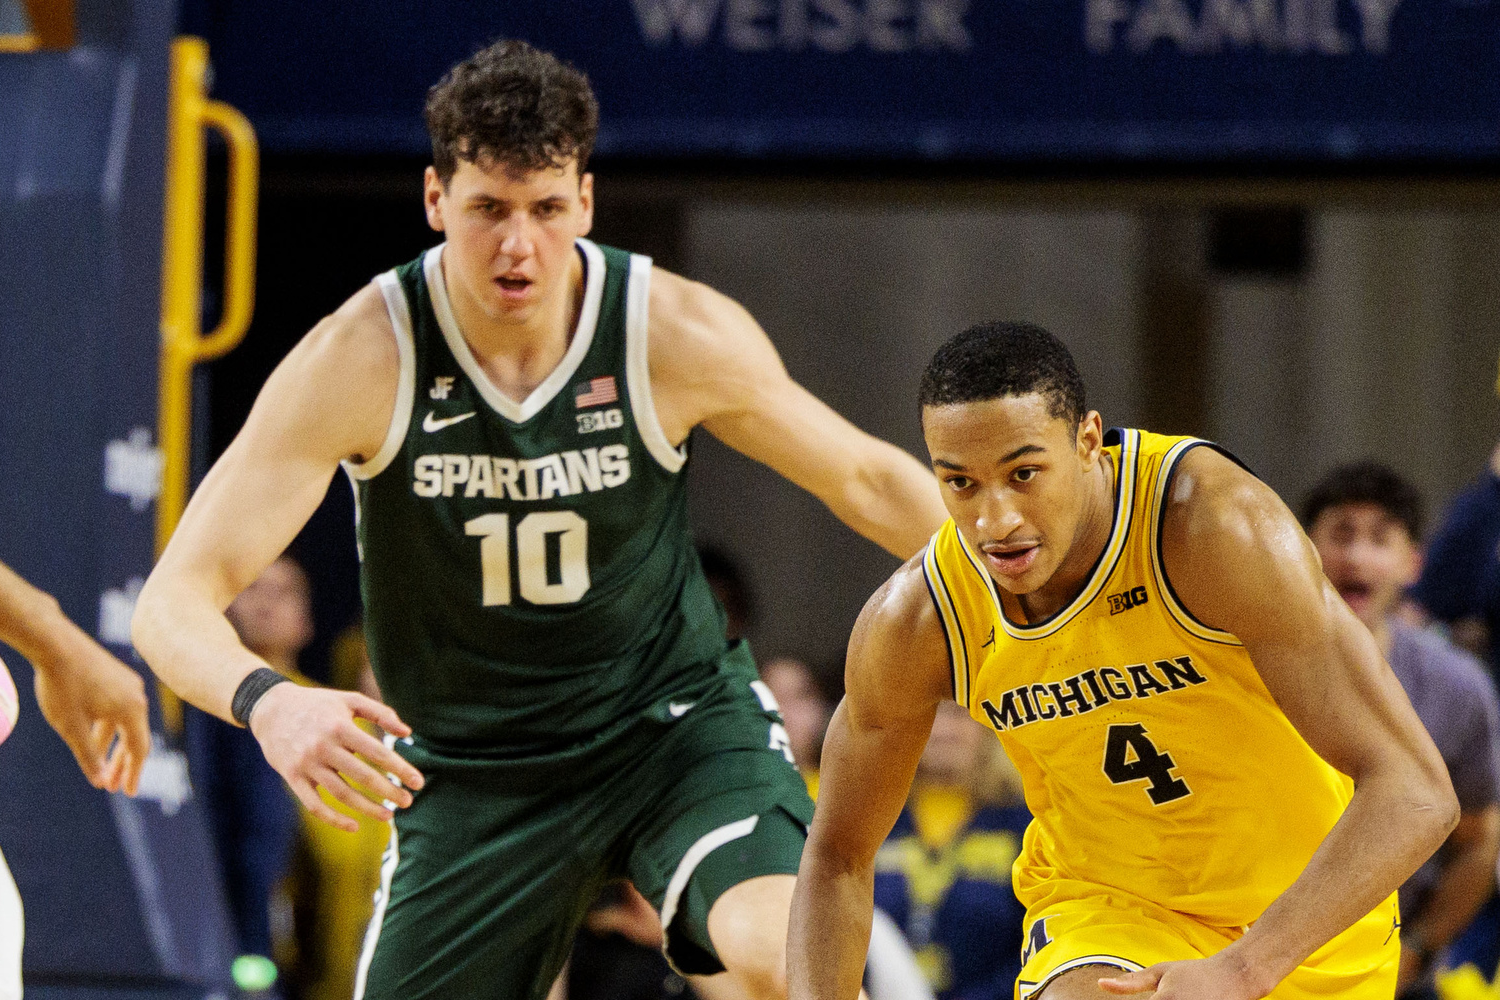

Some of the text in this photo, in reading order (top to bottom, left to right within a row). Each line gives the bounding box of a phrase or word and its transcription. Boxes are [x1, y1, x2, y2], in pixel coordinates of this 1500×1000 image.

[631, 0, 1400, 53] WEISER FAMILY
[413, 443, 632, 501] SPARTANS
[464, 511, 591, 607] 10
[980, 655, 1208, 732] MICHIGAN
[1102, 722, 1194, 807] 4
